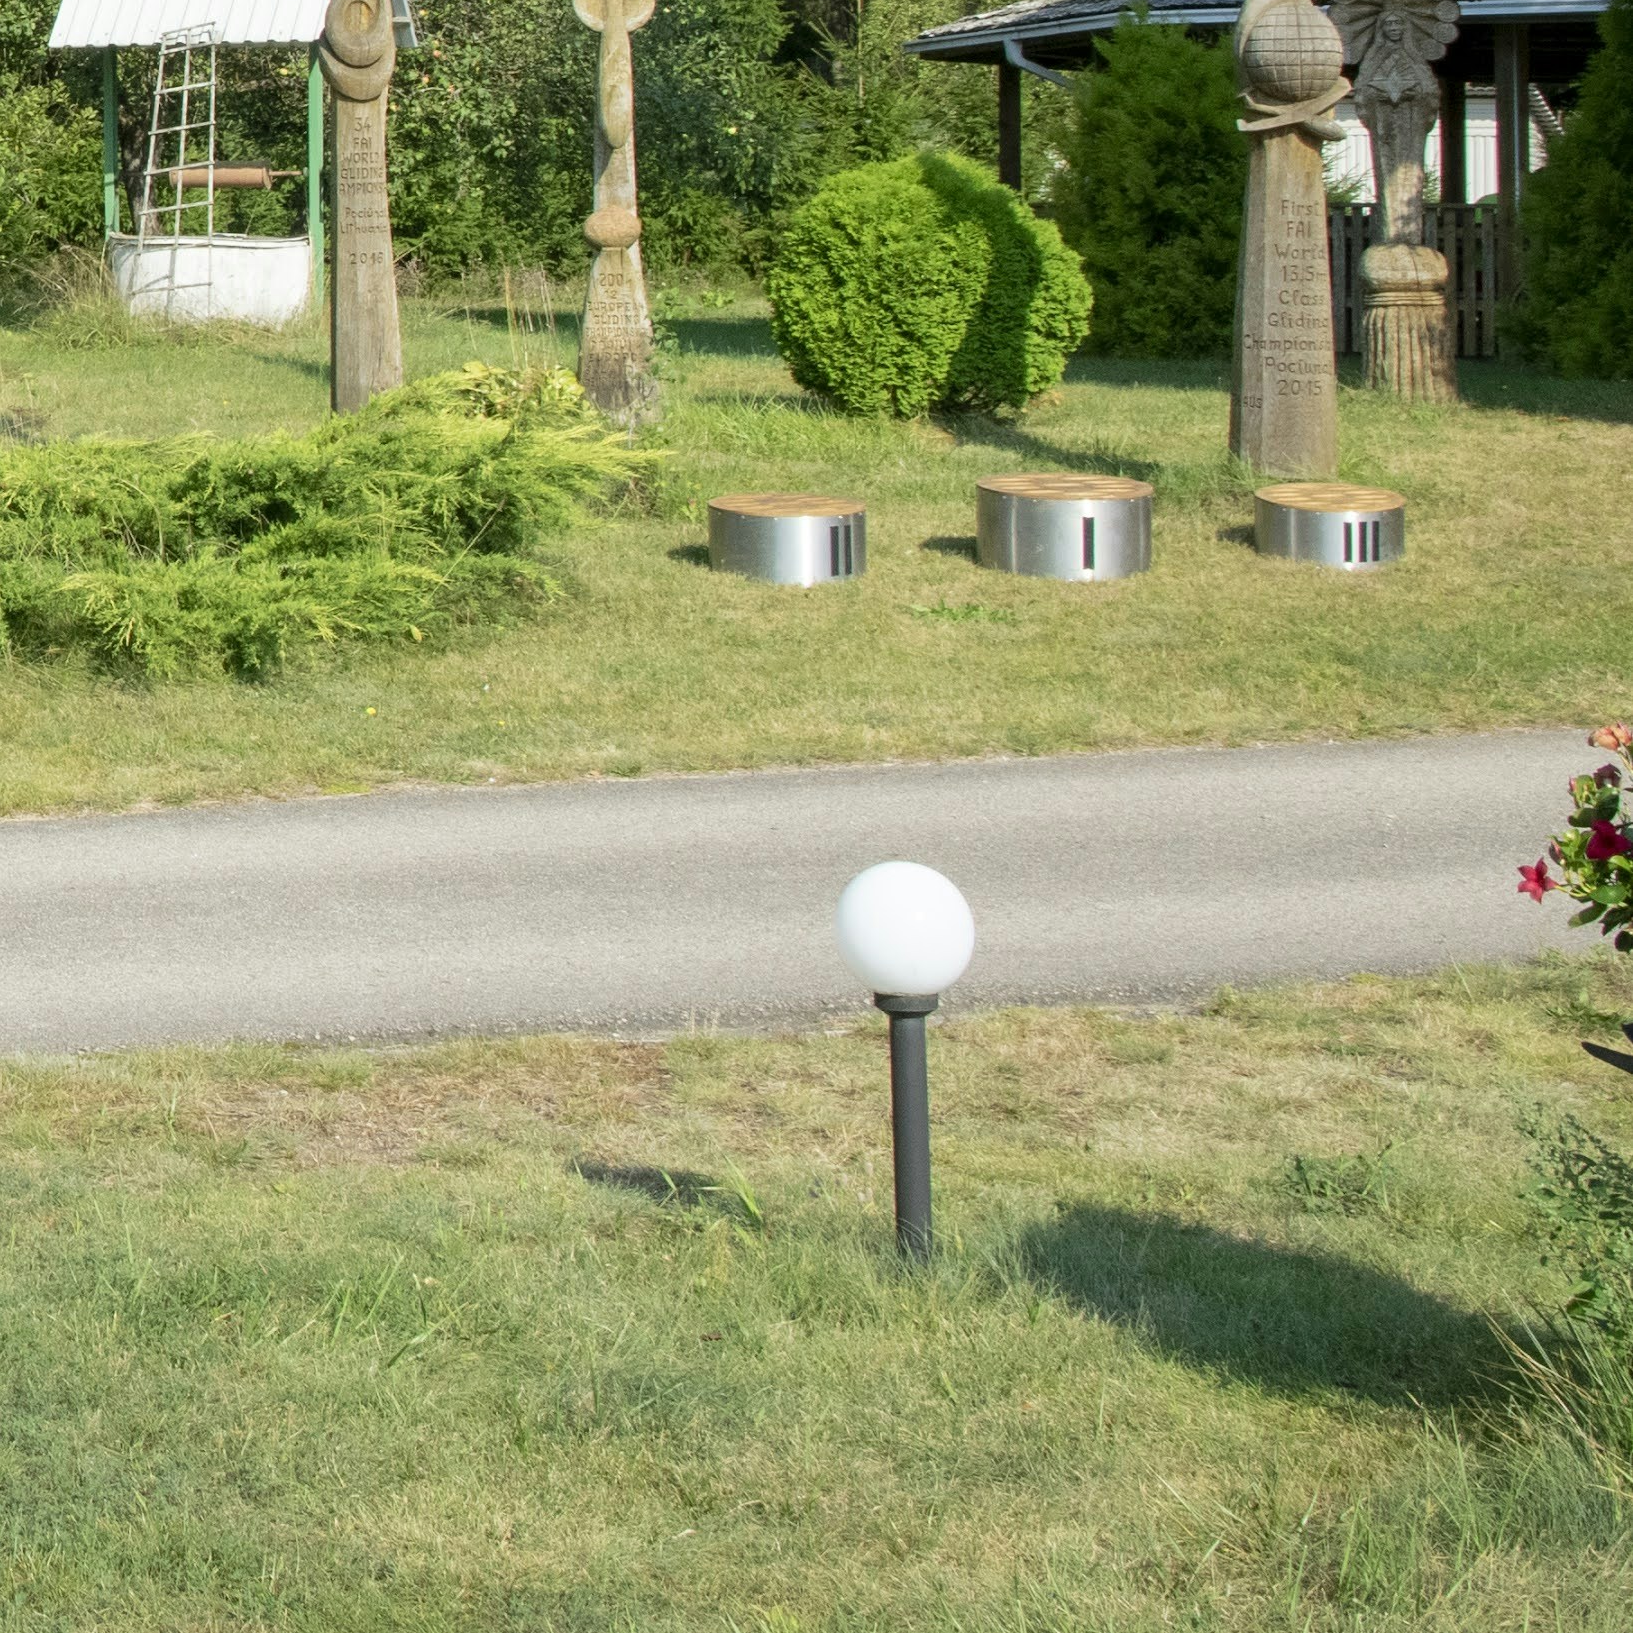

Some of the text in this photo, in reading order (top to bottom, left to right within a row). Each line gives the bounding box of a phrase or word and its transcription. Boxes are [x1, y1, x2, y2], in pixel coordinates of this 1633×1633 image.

[1281, 199, 1322, 216] First
[1287, 220, 1312, 238] FAI
[1279, 290, 1324, 306] Class
[1276, 380, 1322, 396] 2015
